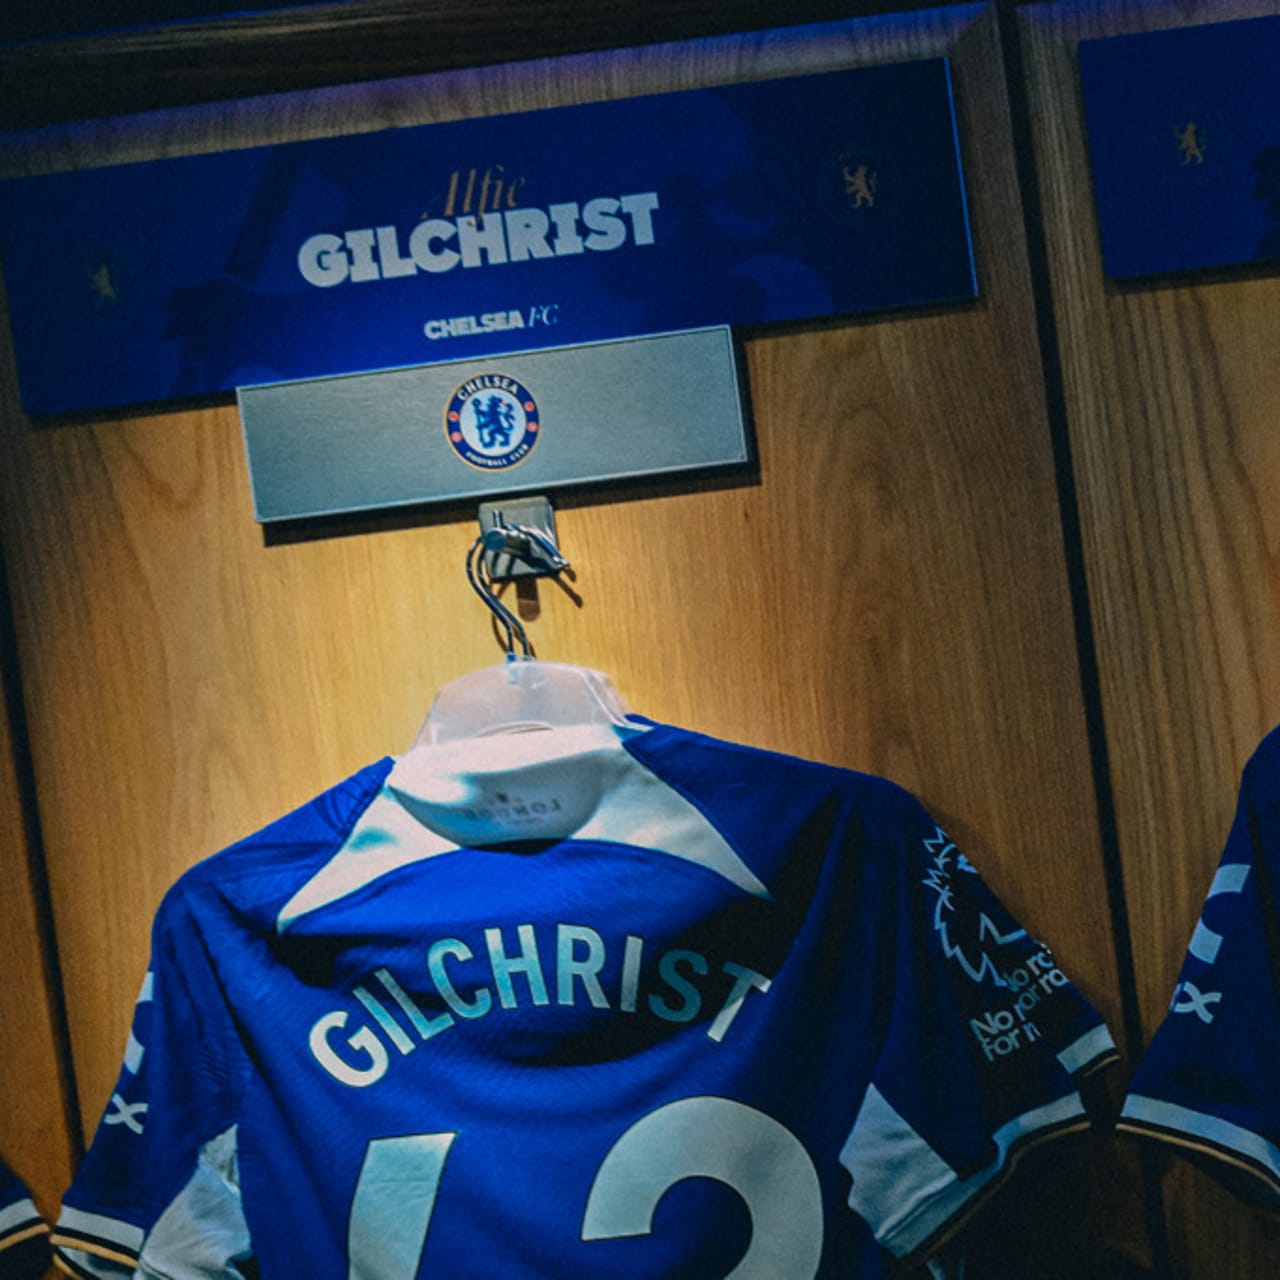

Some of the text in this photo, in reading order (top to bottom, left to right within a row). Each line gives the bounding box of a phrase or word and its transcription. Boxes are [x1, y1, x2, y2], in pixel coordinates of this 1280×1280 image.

[420, 164, 526, 227] Alfie
[298, 192, 660, 288] GILCHRIST
[424, 304, 559, 340] CHELSEA FC
[457, 376, 518, 400] CHELSEA
[308, 924, 773, 1088] GILCHRIST
[969, 1010, 1014, 1041] No
